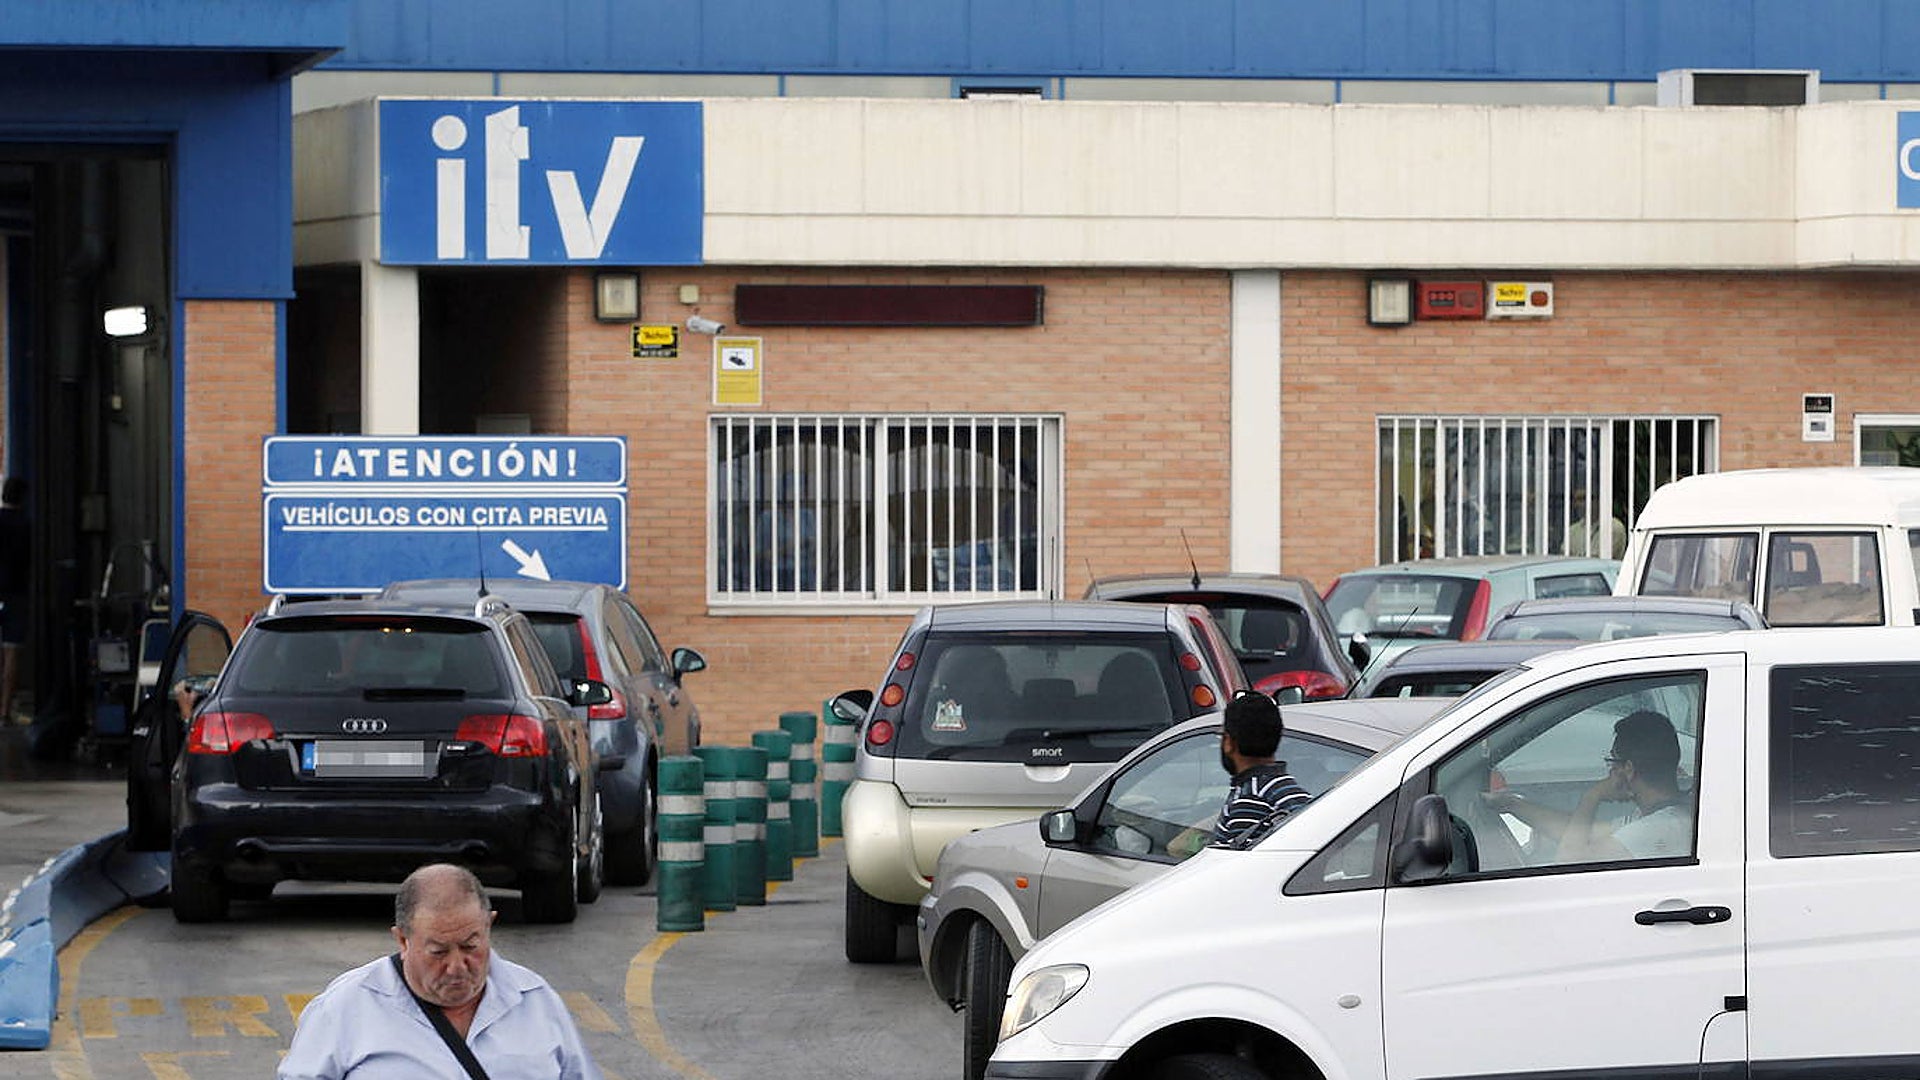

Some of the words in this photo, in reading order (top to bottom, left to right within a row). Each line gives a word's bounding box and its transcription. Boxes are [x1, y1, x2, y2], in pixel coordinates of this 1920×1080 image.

[431, 104, 645, 260] itv
[314, 443, 577, 477] ¡ATENCIÓN!
[282, 502, 410, 526] VEHÍCULOS
[416, 506, 466, 526] CON
[471, 506, 523, 526] CITA
[528, 506, 609, 526] PREVIA
[1032, 748, 1063, 757] smart
